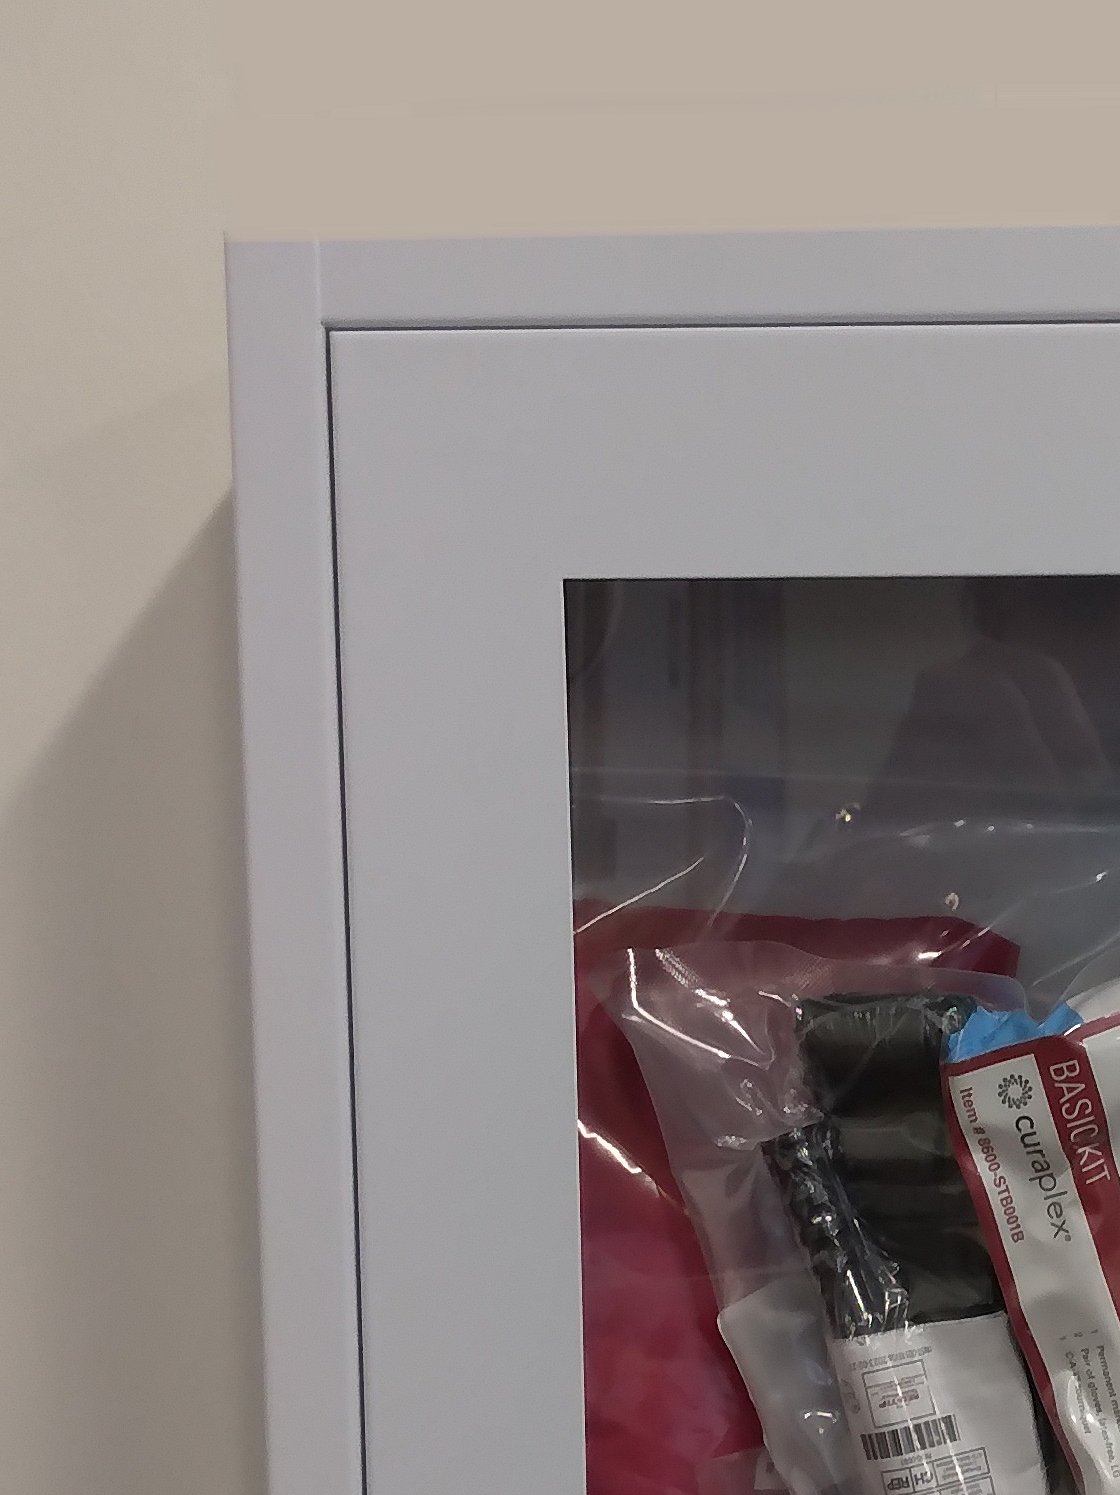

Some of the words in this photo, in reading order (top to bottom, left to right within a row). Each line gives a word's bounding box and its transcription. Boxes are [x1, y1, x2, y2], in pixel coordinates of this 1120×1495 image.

[959, 1086, 978, 1124] Item
[1049, 1058, 1098, 1143] BASIC
[1076, 1145, 1110, 1185] KIT
[1015, 1114, 1068, 1239] curaplex
[886, 1476, 910, 1491] REP
